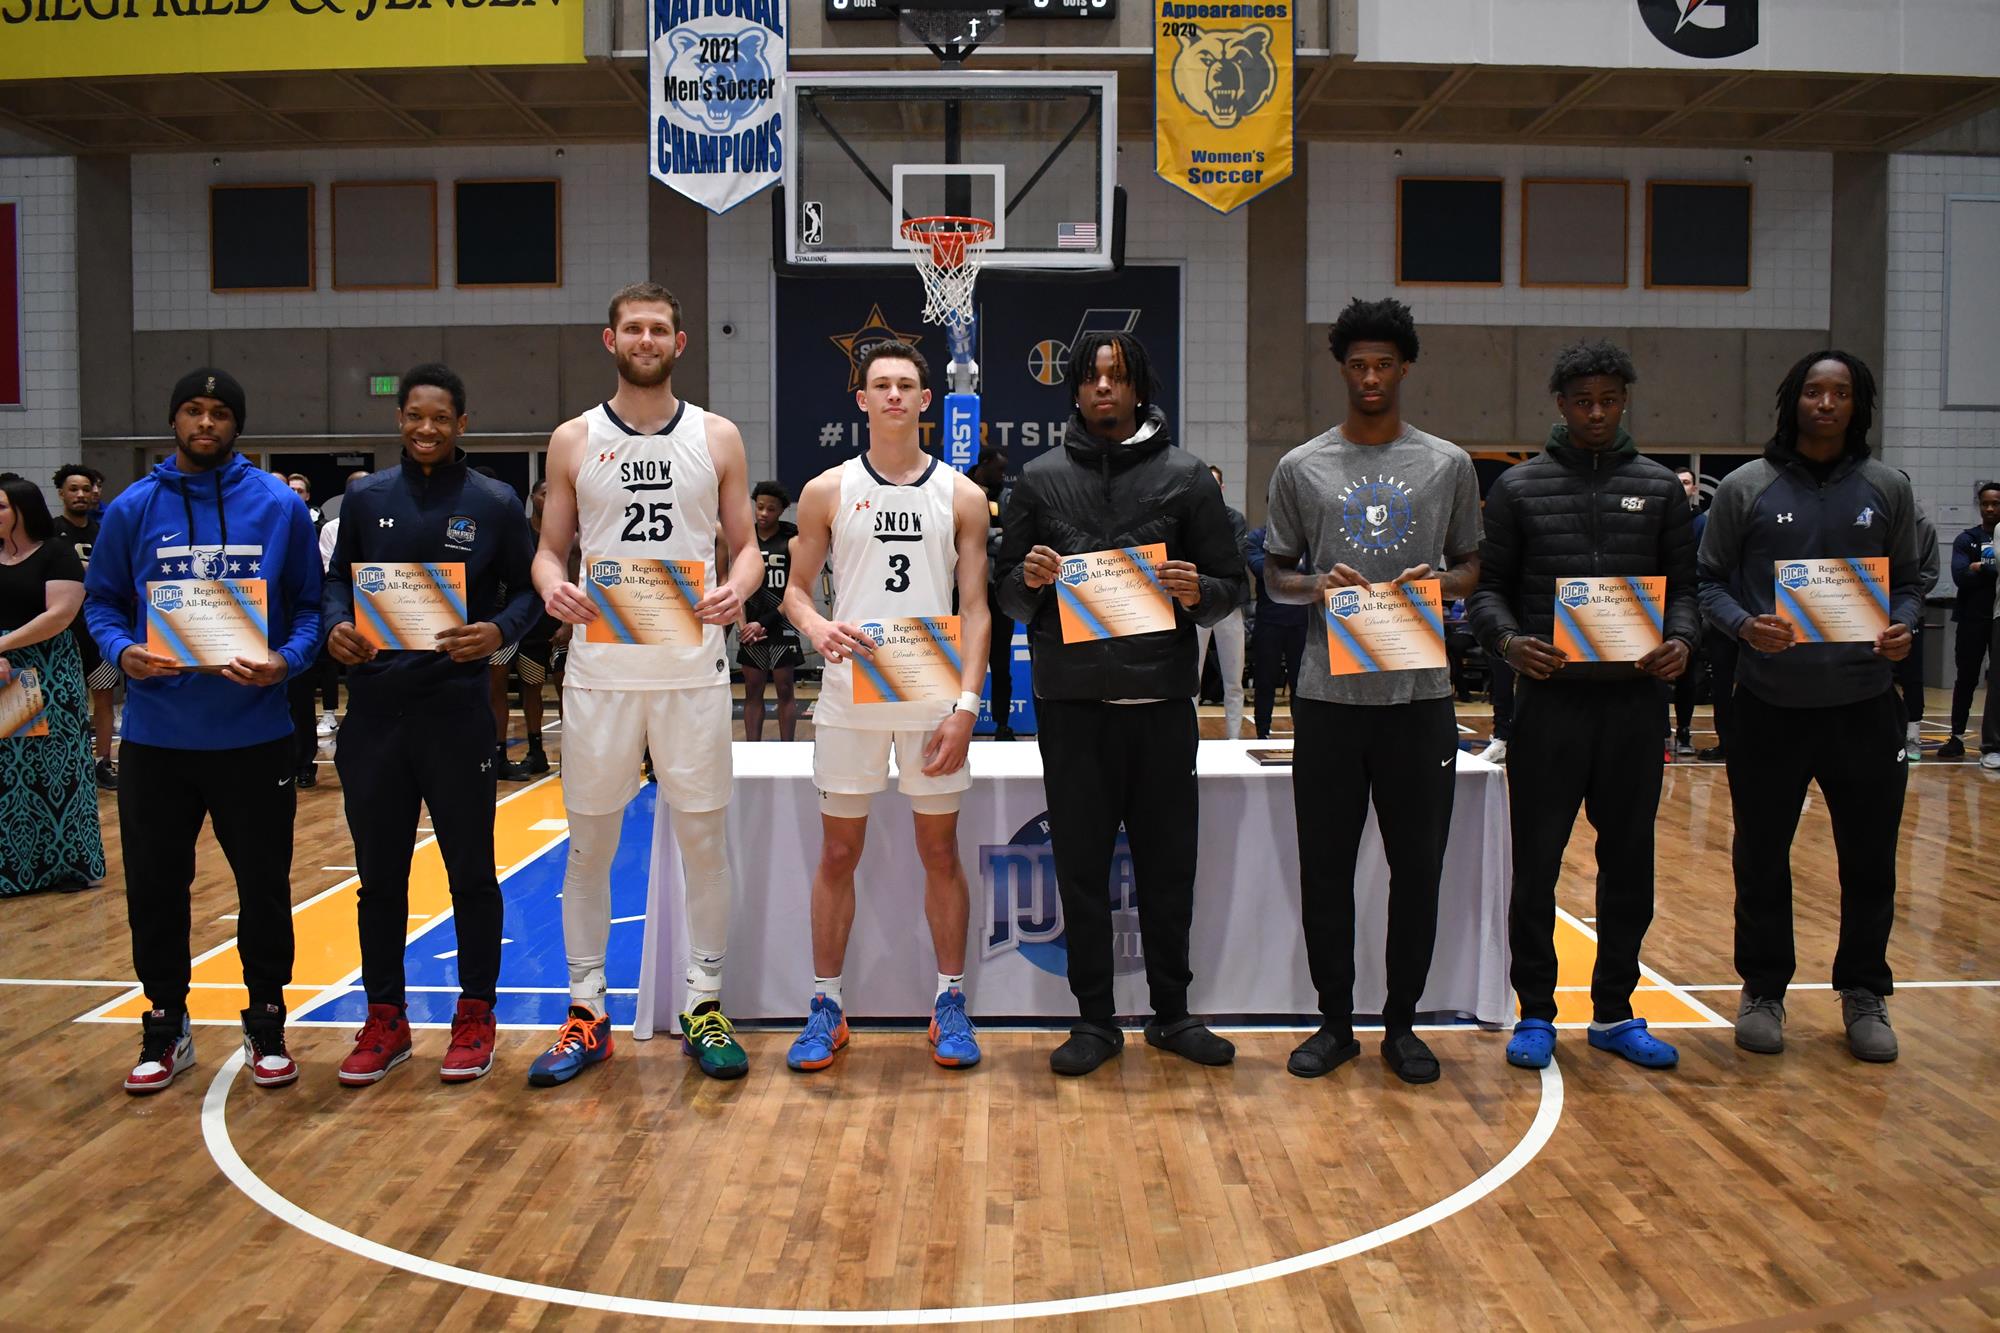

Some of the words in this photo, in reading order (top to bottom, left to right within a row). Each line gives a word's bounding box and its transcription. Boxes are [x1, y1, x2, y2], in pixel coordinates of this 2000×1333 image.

[1162, 2, 1287, 18] Appearances
[1163, 23, 1197, 37] 2020
[700, 37, 738, 64] 2021
[664, 76, 712, 101] Men's
[716, 76, 775, 101] Soccer
[658, 112, 782, 174] CHAMPIONS
[1191, 150, 1264, 163] Women's
[1188, 168, 1264, 184] Soccer
[621, 461, 672, 482] SNOW
[621, 503, 673, 541] 25
[874, 511, 922, 532] SNOW
[1096, 554, 1127, 566] Region
[395, 569, 425, 579] Region
[592, 564, 622, 578] NJCAA
[632, 564, 663, 574] Region
[885, 553, 910, 592] 3
[1060, 562, 1088, 579] NJCAA
[1090, 567, 1135, 580] All-Region
[1137, 565, 1157, 573] Awa
[1780, 567, 1809, 581] NJCAA
[1818, 565, 1848, 574] Region
[358, 571, 386, 584] NJCAA
[623, 576, 670, 587] All-Region
[767, 569, 785, 587] 10
[1809, 576, 1855, 586] All-Region
[193, 586, 225, 597] Region
[387, 581, 432, 592] All-Region
[1561, 585, 1590, 599] NJCAA
[1598, 583, 1627, 592] Region
[152, 589, 184, 603] NJCAA
[1369, 589, 1399, 599] Region
[1590, 595, 1633, 605] All-Region
[185, 598, 232, 608] All-Region
[1331, 594, 1360, 610] NJCAA
[1361, 601, 1408, 611] All-Region
[860, 626, 884, 637] CAA
[893, 623, 922, 634] Region
[885, 635, 929, 645] All-Region
